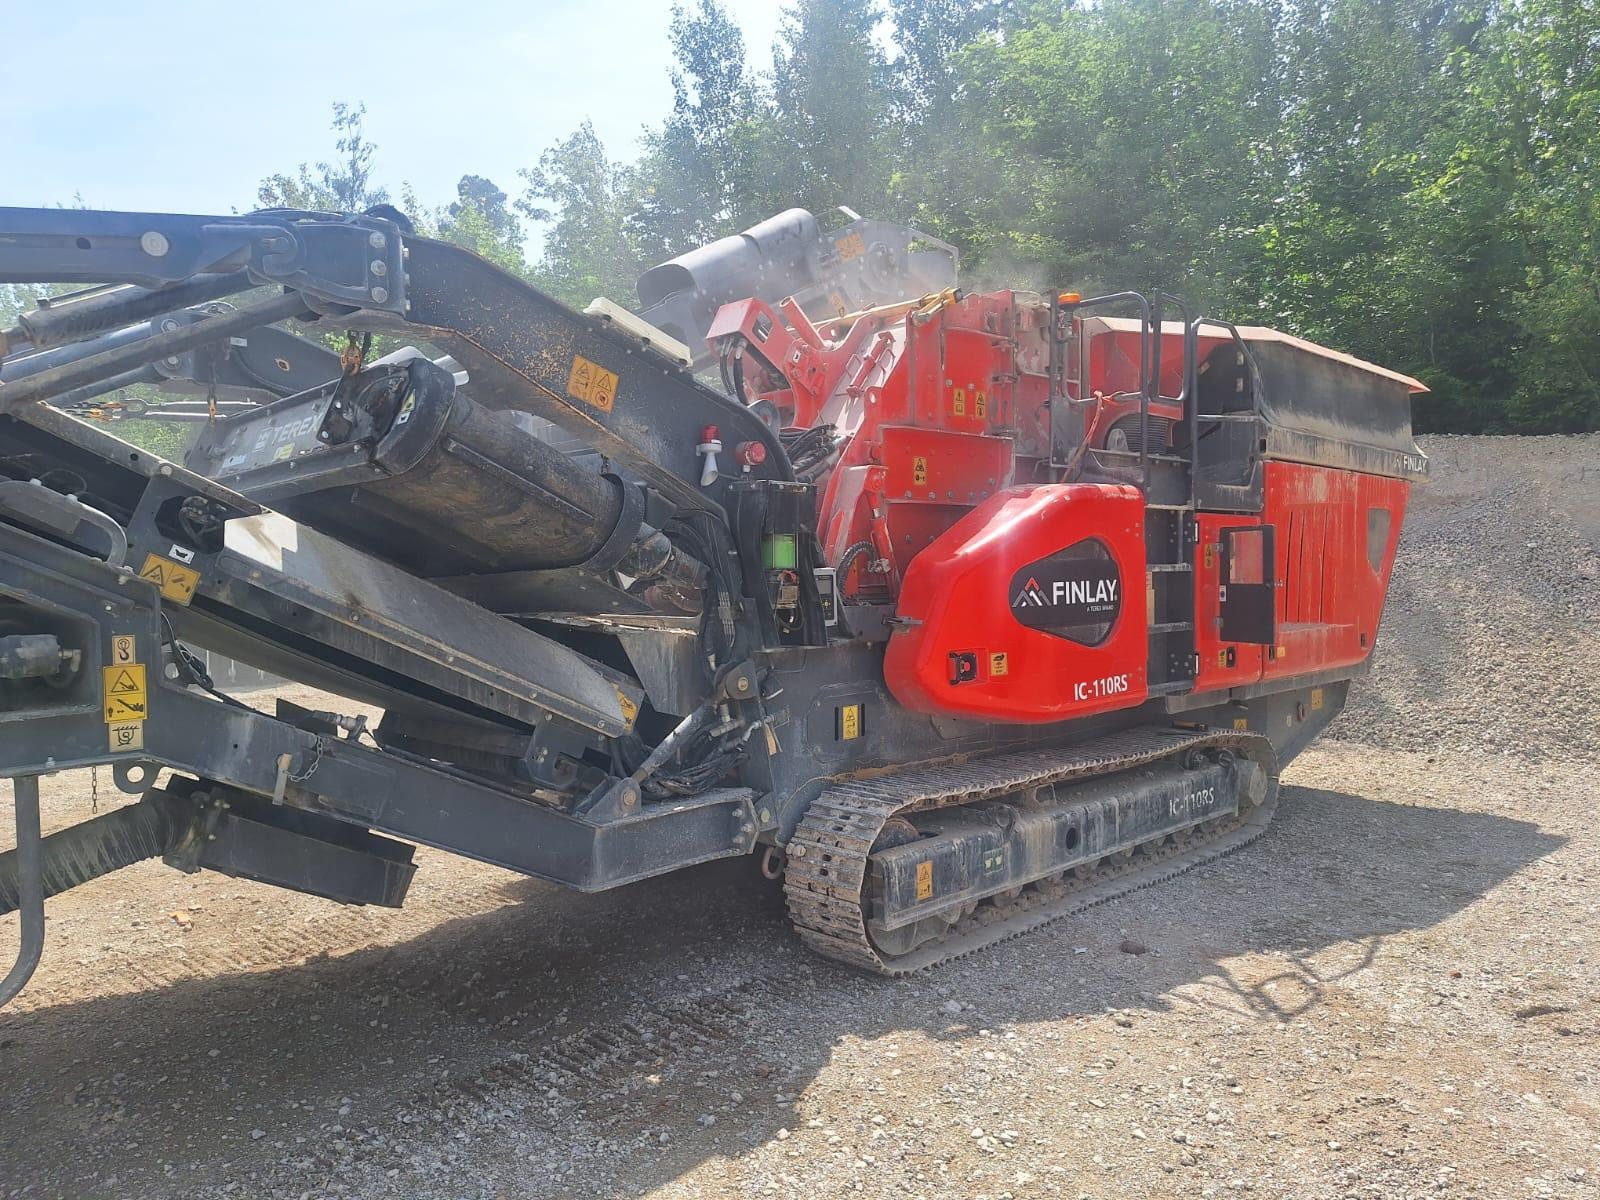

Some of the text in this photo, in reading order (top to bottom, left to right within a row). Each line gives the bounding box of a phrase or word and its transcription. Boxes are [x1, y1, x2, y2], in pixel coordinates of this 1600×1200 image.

[271, 413, 325, 444] TEREX
[1403, 455, 1427, 472] FINLAY
[1052, 579, 1117, 605] FINLAY
[1074, 674, 1128, 701] IC-110RS
[1169, 787, 1214, 817] IC-110RS
